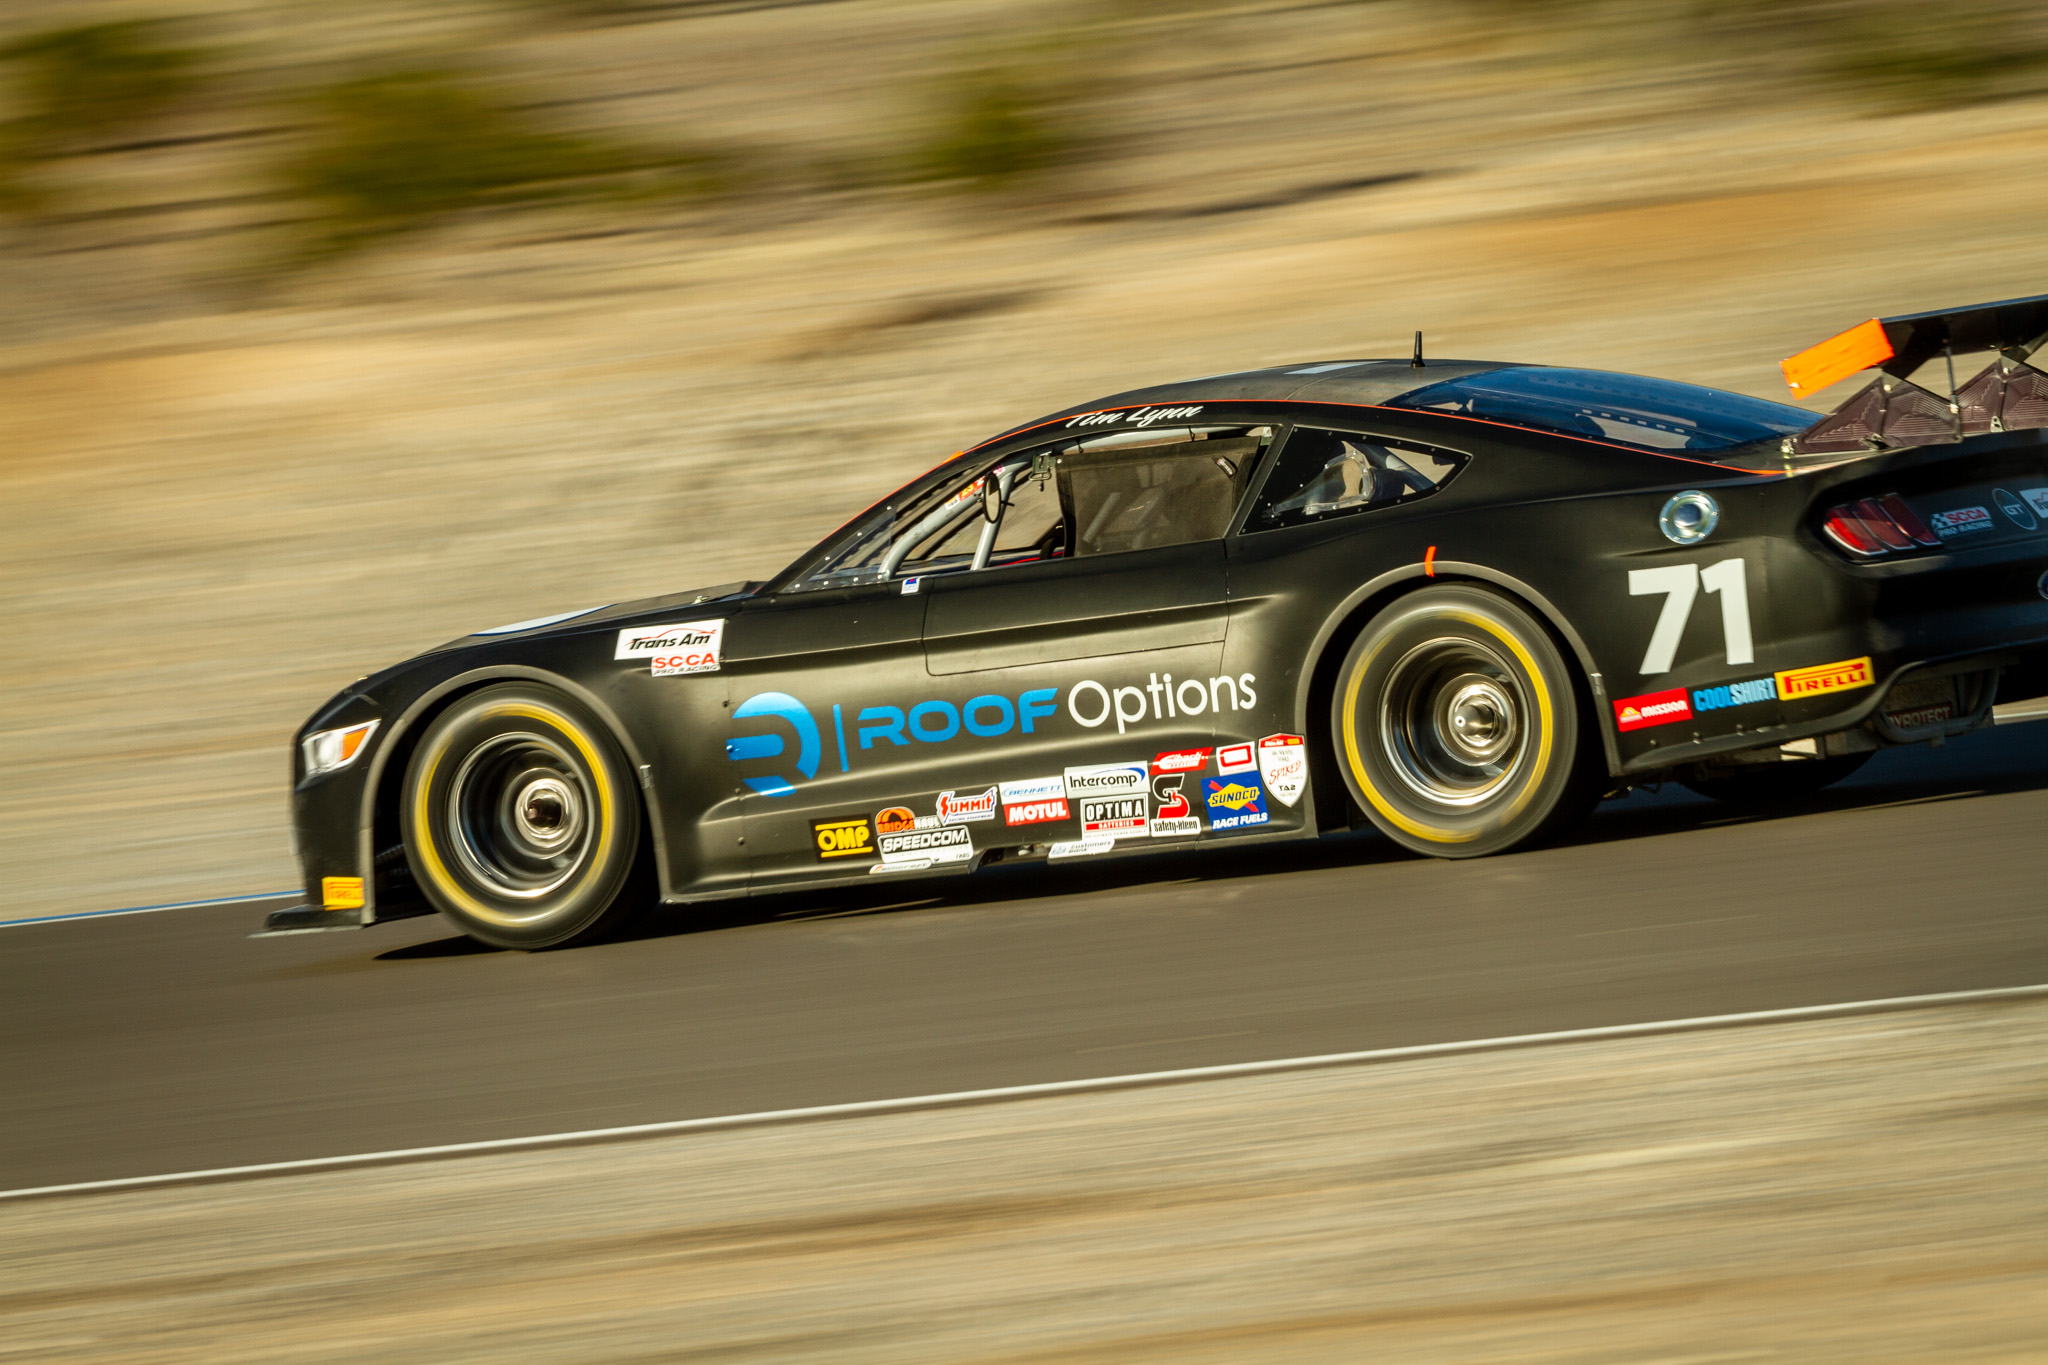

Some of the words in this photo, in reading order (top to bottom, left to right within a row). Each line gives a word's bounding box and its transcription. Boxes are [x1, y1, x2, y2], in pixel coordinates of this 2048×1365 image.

[1065, 412, 1125, 428] Tim
[1126, 406, 1204, 427] Lynn
[1946, 508, 1988, 524] SCCA
[2003, 504, 2025, 515] GT
[1938, 527, 1957, 537] PRO
[1959, 520, 1993, 532] RACING
[1627, 558, 1754, 675] 71
[629, 637, 678, 650] Trans
[678, 633, 710, 646] Am
[653, 653, 716, 669] SCCA
[1784, 662, 1867, 694] PIRELLI
[857, 687, 1058, 749] ROOF
[1068, 672, 1257, 734] Options
[1069, 774, 1138, 788] Intercomp
[1008, 785, 1062, 796] BENNETT
[1211, 789, 1257, 805] SUNOCO
[1009, 801, 1067, 823] MOTUL
[1085, 800, 1144, 821] OPTIMA
[1154, 820, 1198, 833] safety-kleen
[1212, 816, 1239, 829] RACE
[1240, 812, 1268, 825] FUELS
[818, 826, 870, 851] OMP
[883, 829, 966, 853] SPEEDCOM
